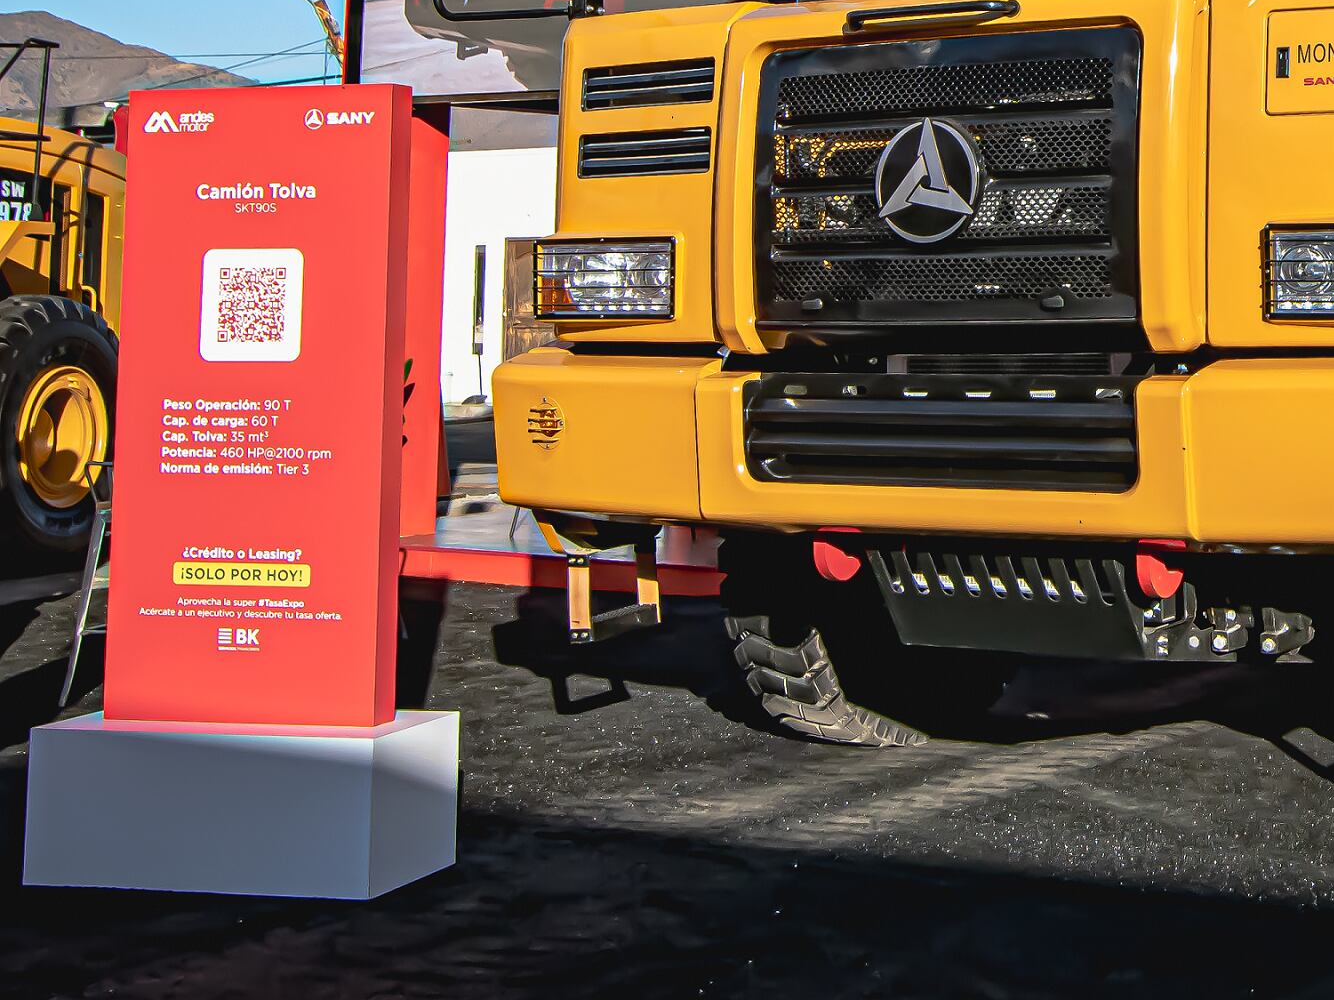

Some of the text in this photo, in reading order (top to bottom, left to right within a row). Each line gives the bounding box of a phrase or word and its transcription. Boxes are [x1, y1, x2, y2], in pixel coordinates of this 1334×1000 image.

[178, 110, 215, 125] andes
[325, 111, 376, 125] SANY
[178, 121, 210, 133] motor
[1, 179, 26, 198] SW
[196, 183, 317, 201] Camión Tolva
[234, 202, 278, 214] SKT90S
[162, 398, 292, 414] Peso Operación: 90 T
[162, 415, 279, 429] Cap. de carga: 60 T
[161, 431, 189, 444] Cap.
[192, 431, 228, 443] Tolva:
[230, 431, 245, 443] 35
[161, 447, 332, 462] Potencia: 460 HP@2100 rpm
[160, 463, 310, 476] Norma de emisión: Tier 3
[182, 546, 303, 562] ¿Crédito o Leasing?
[180, 567, 304, 583] ¡SOLO POR HOY!
[177, 597, 305, 609] Aprovecha la super #TasaExpo
[139, 606, 343, 621] Acércate a un ejecutivo y descubre tu tasa oferta.
[235, 628, 260, 646] BK
